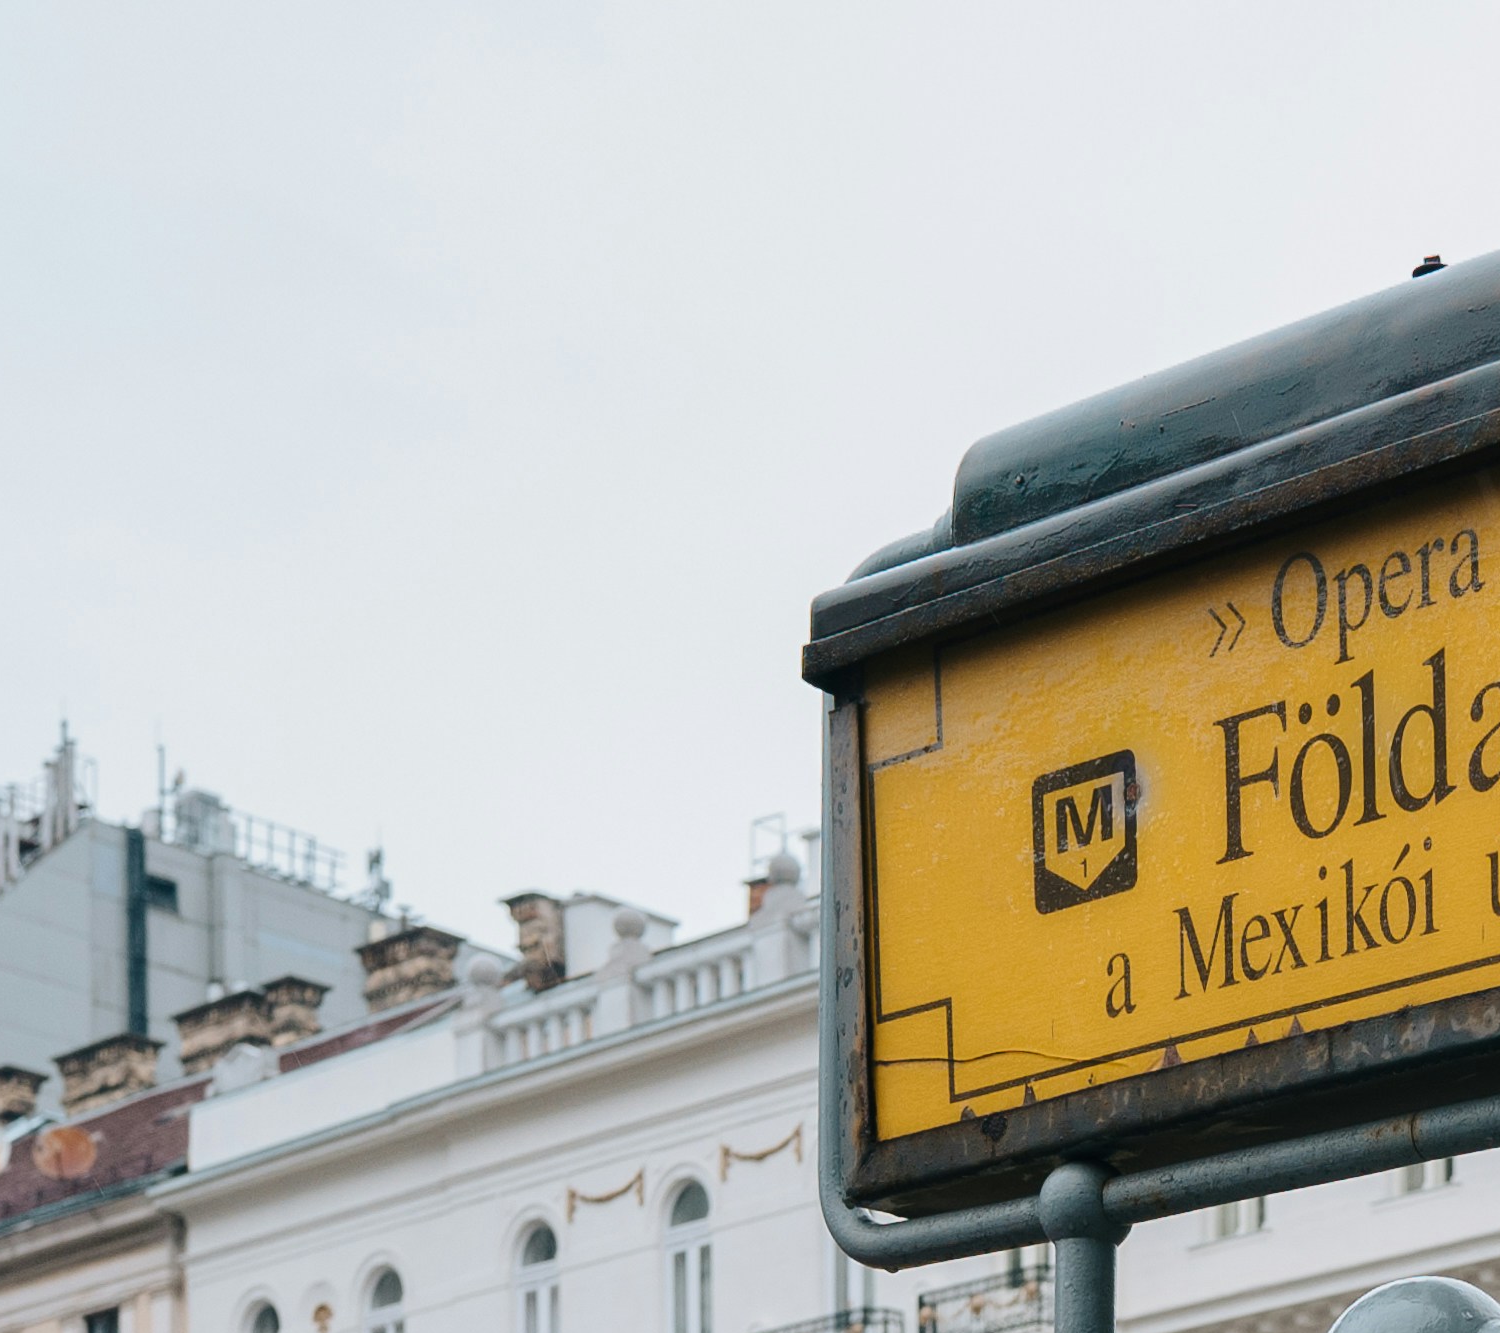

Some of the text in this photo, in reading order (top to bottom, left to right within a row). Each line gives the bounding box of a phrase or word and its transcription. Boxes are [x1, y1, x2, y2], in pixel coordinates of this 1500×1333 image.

[1271, 527, 1485, 664] Opera
[1104, 950, 1138, 1020] a
[1173, 837, 1440, 996] Mexikói
